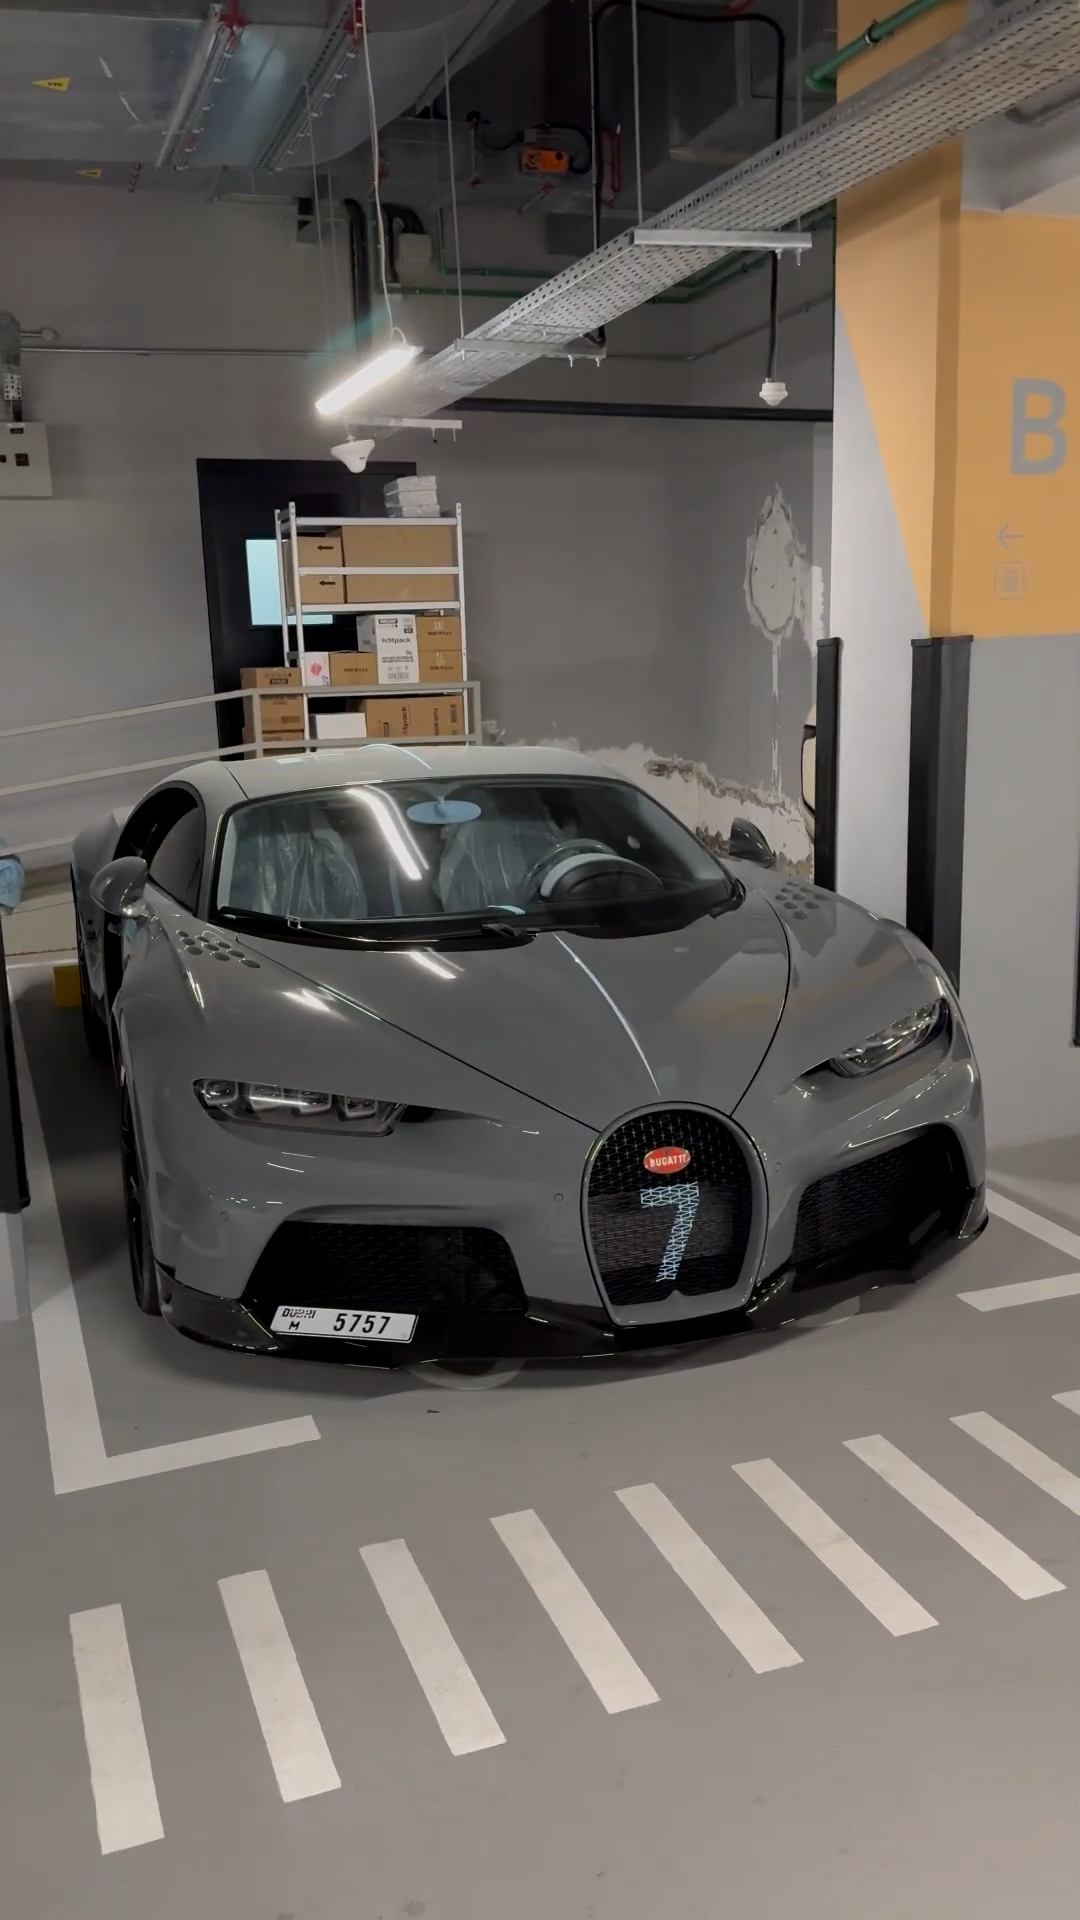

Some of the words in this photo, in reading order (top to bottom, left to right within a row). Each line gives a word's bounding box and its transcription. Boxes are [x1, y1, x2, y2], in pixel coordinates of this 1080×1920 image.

[1010, 377, 1068, 475] B
[649, 1153, 686, 1168] BUGATTI
[640, 1181, 700, 1282] 7
[282, 1308, 316, 1319] DUBAI
[333, 1313, 391, 1334] 5757
[289, 1321, 300, 1330] M
